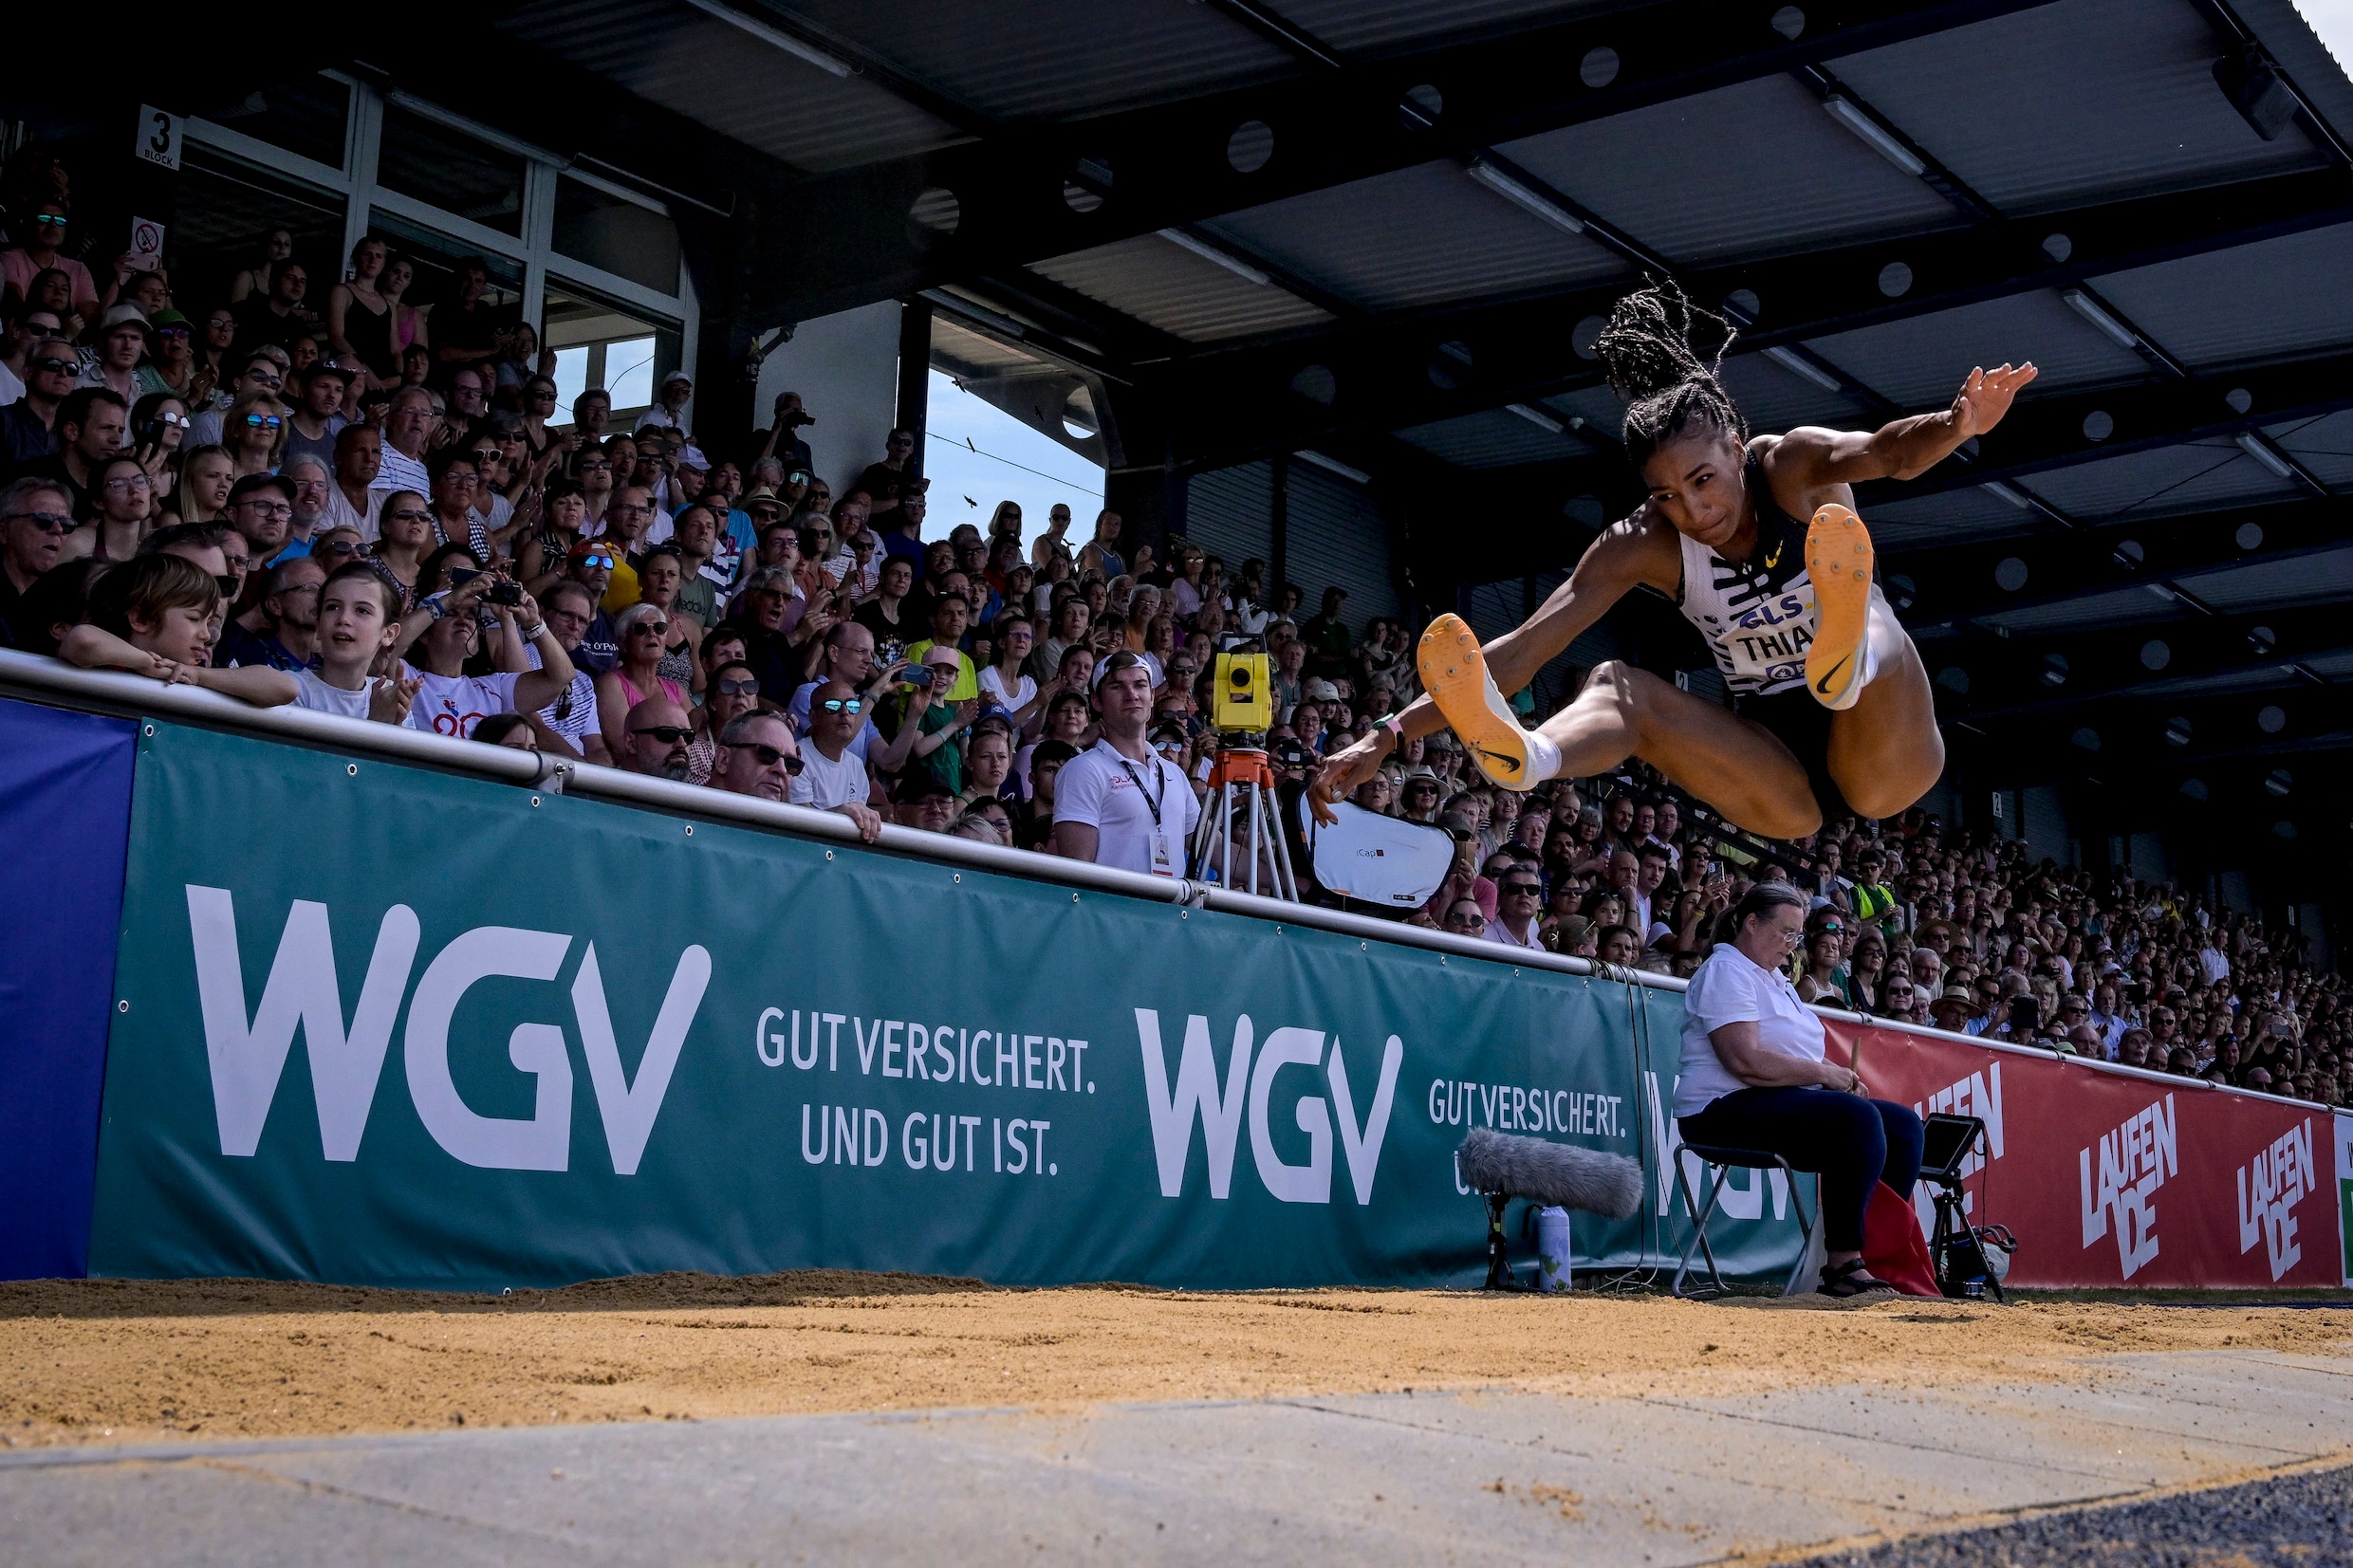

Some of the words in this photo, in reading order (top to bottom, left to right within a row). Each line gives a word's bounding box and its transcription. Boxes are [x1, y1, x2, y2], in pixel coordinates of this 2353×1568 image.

[144, 150, 174, 167] BLOCK
[151, 112, 170, 154] 3
[1735, 617, 1814, 662] THIA
[184, 883, 713, 1175] WGV
[756, 1005, 846, 1072] GUT
[855, 1017, 1096, 1095] VERSICHERT.
[800, 1103, 889, 1167] UND
[901, 1111, 980, 1172] GUT
[991, 1115, 1059, 1177] IST.
[1134, 1007, 1404, 1206] WGV
[1429, 1079, 1476, 1126] GUT
[1480, 1083, 1626, 1137] VERSICHERT.
[2080, 1092, 2177, 1249] LAUFEN
[2237, 1116, 2316, 1255] LAUFEN
